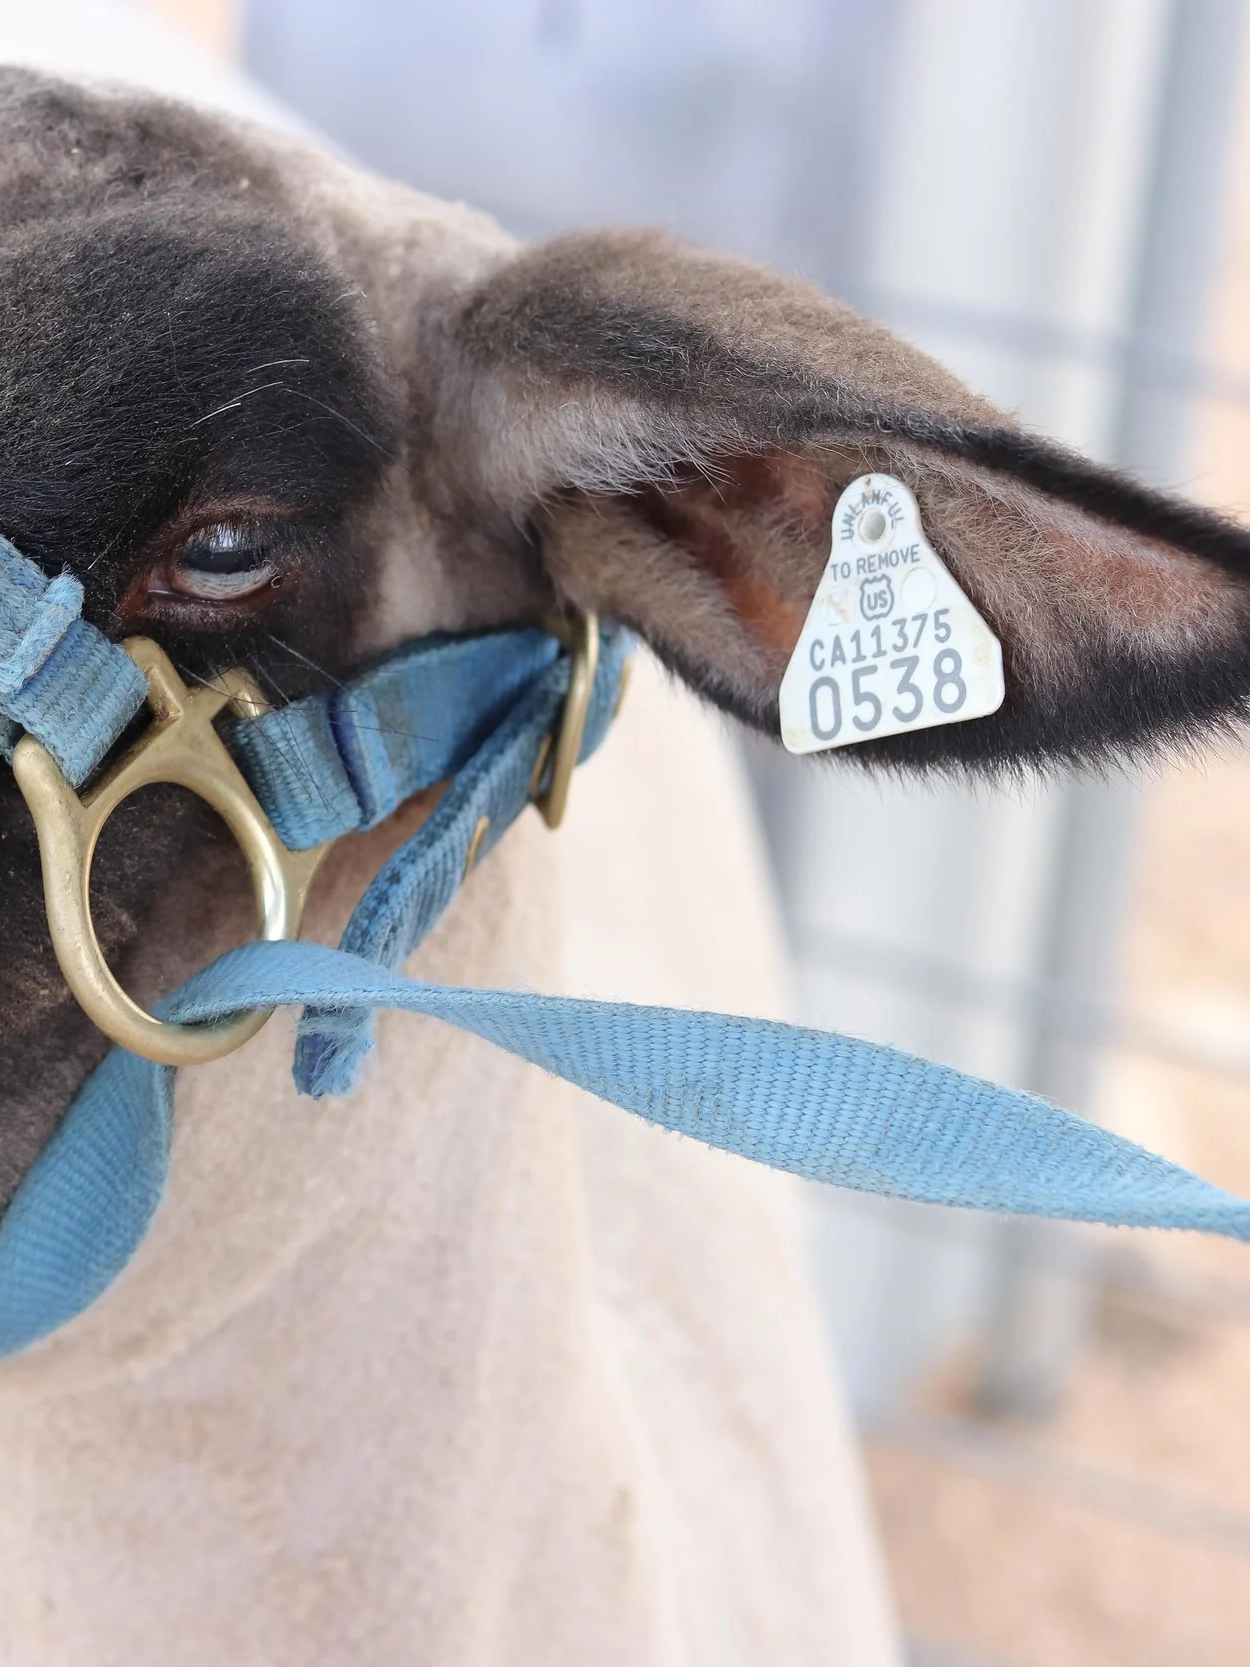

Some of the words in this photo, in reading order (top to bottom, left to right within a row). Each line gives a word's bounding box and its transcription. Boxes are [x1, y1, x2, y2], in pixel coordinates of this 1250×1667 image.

[841, 489, 904, 540] UNLAWFUL
[831, 561, 851, 581] TO
[856, 543, 922, 577] REMOVE
[867, 591, 888, 611] US
[809, 608, 952, 672] CA11375
[809, 647, 967, 741] 0538
